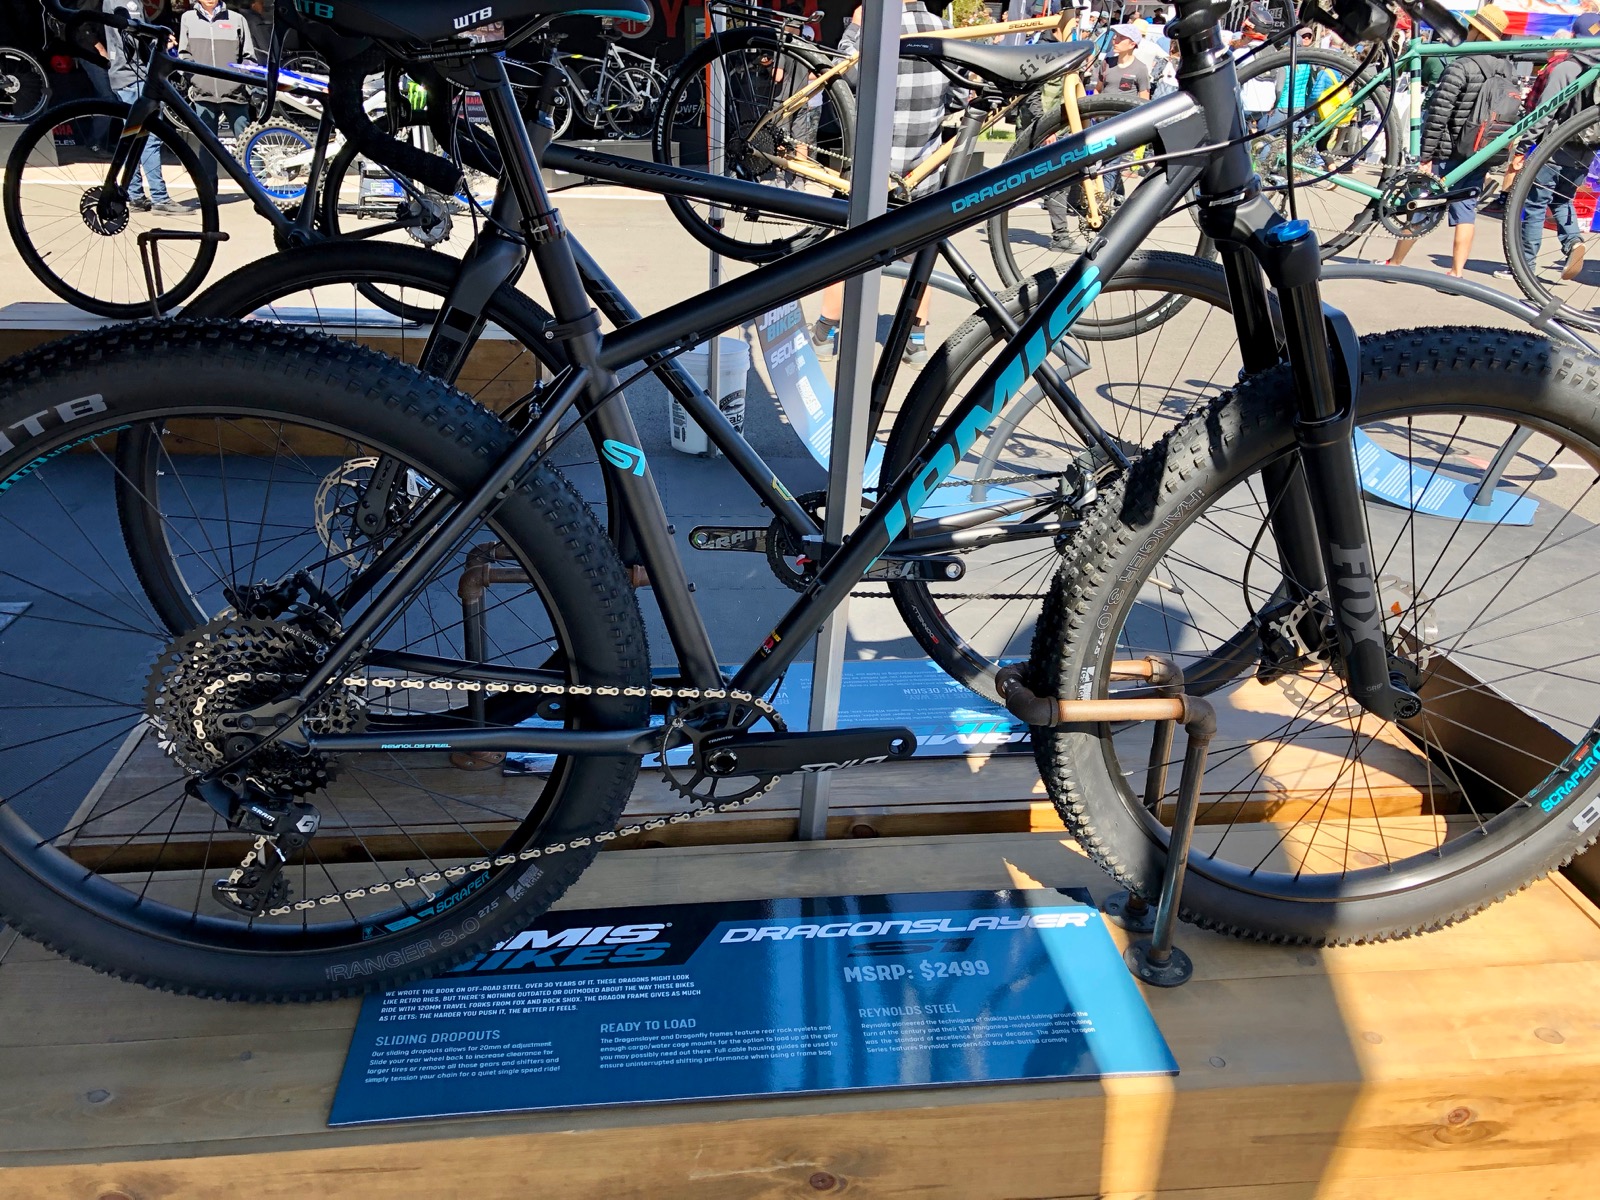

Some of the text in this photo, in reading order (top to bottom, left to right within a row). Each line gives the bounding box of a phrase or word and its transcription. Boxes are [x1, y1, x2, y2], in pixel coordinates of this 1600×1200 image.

[453, 6, 492, 30] WTB
[1508, 81, 1580, 139] JAMIS
[574, 153, 709, 186] RENEGADE
[951, 134, 1118, 214] DRAGONSLAYER
[0, 393, 108, 457] TB
[1119, 491, 1202, 583] RANGER
[1097, 587, 1126, 630] 3.0
[1330, 542, 1386, 650] FOX
[280, 625, 300, 637] EAGLE
[902, 687, 941, 696] DESIGN
[1366, 681, 1384, 692] GRIP
[1541, 755, 1598, 813] SCRAPER
[251, 806, 276, 822] SRAM
[435, 870, 491, 914] SCRAPER
[331, 897, 501, 983] RANGER 3.0 27.5
[718, 911, 1091, 944] DRAGONSLAYER
[466, 984, 501, 992] OFF-ROAD
[617, 976, 649, 984] DRAGONS
[843, 958, 990, 985] MSRP: $2499
[562, 987, 600, 995] OUTMODED
[432, 1011, 461, 1019] HARDER
[858, 1003, 960, 1018] REYNOLDS STEEL
[374, 1029, 501, 1046] SLIDING DROPOUTS
[599, 1019, 696, 1033] READY TO LOAD
